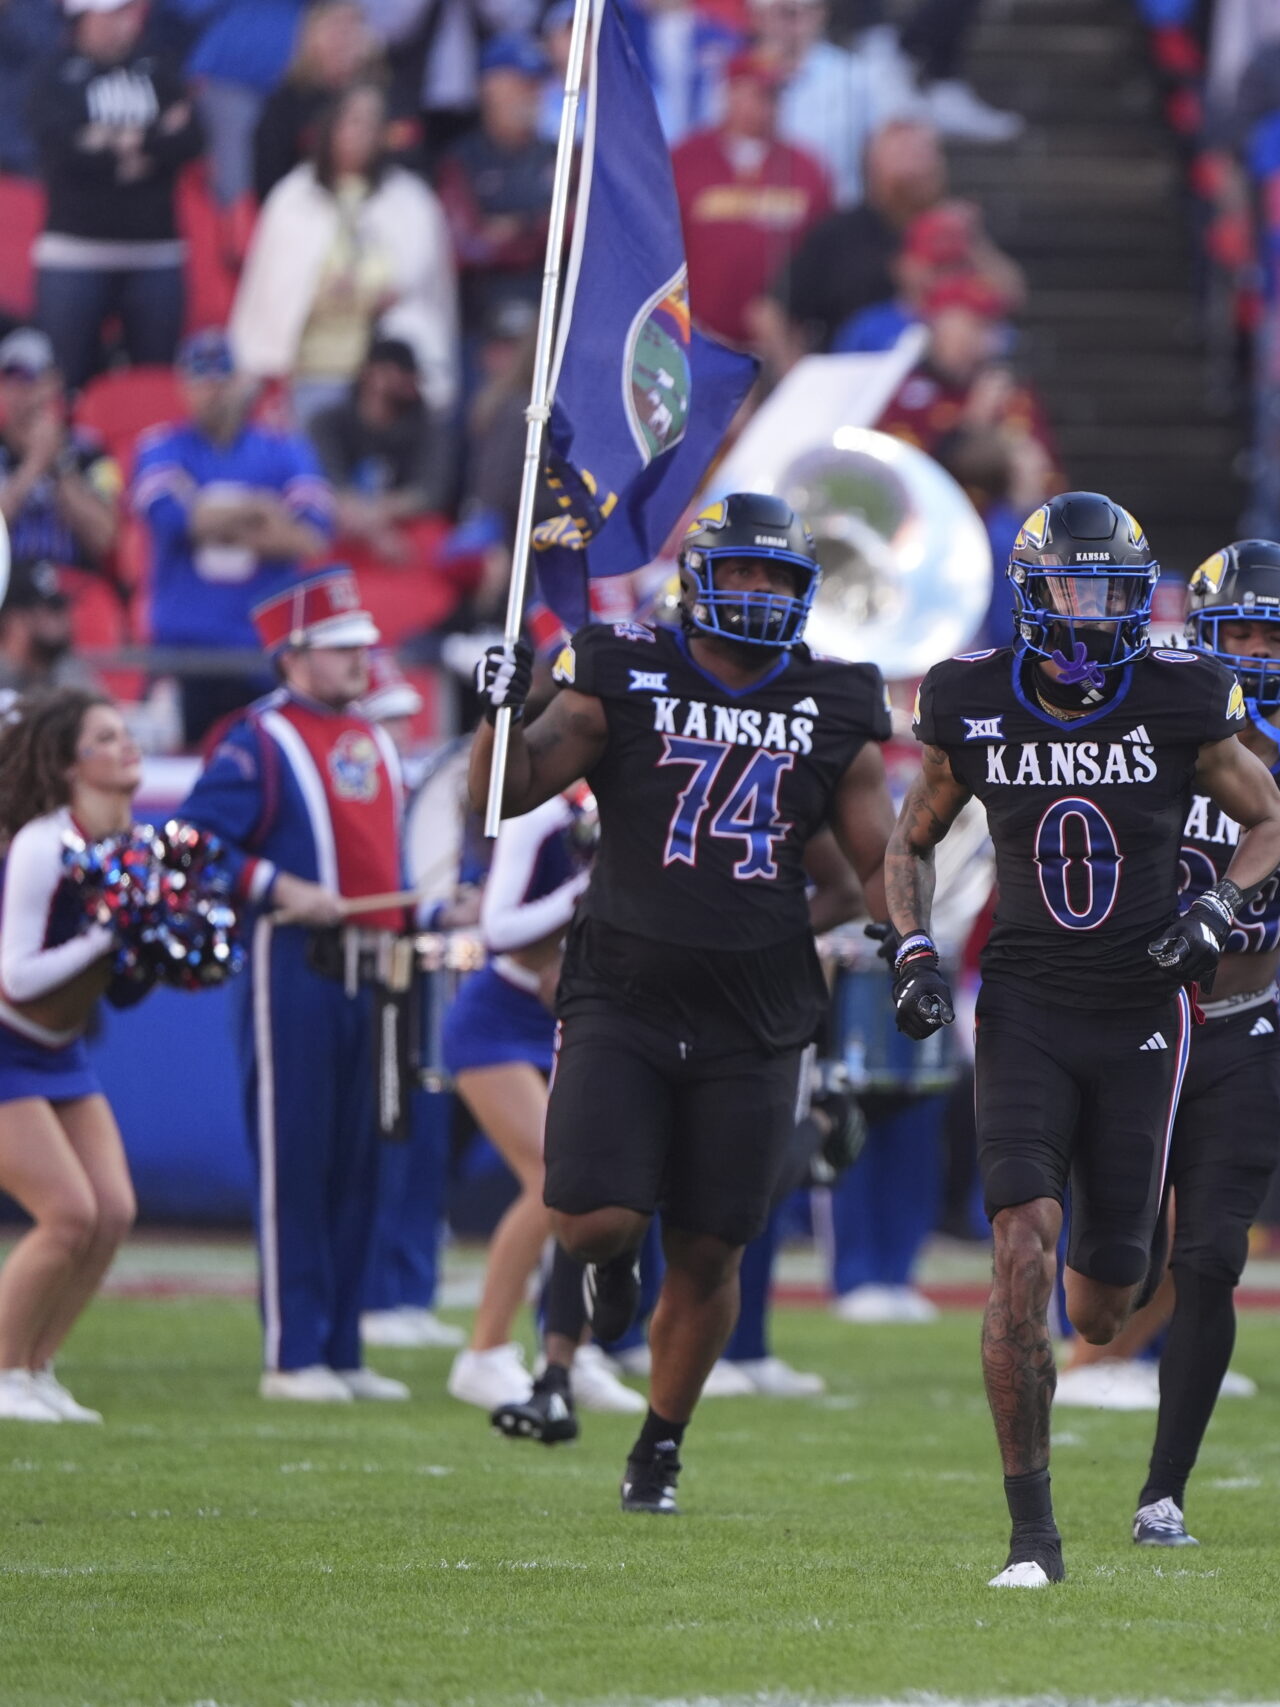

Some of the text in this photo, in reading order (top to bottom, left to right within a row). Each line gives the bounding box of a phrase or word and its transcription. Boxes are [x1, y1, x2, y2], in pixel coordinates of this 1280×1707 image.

[1076, 552, 1110, 561] KANSAS
[652, 697, 814, 754] KANSAS
[963, 717, 1005, 739] XII
[985, 742, 1158, 786] KANSAS
[656, 733, 795, 880] 74
[1032, 796, 1126, 931] 0
